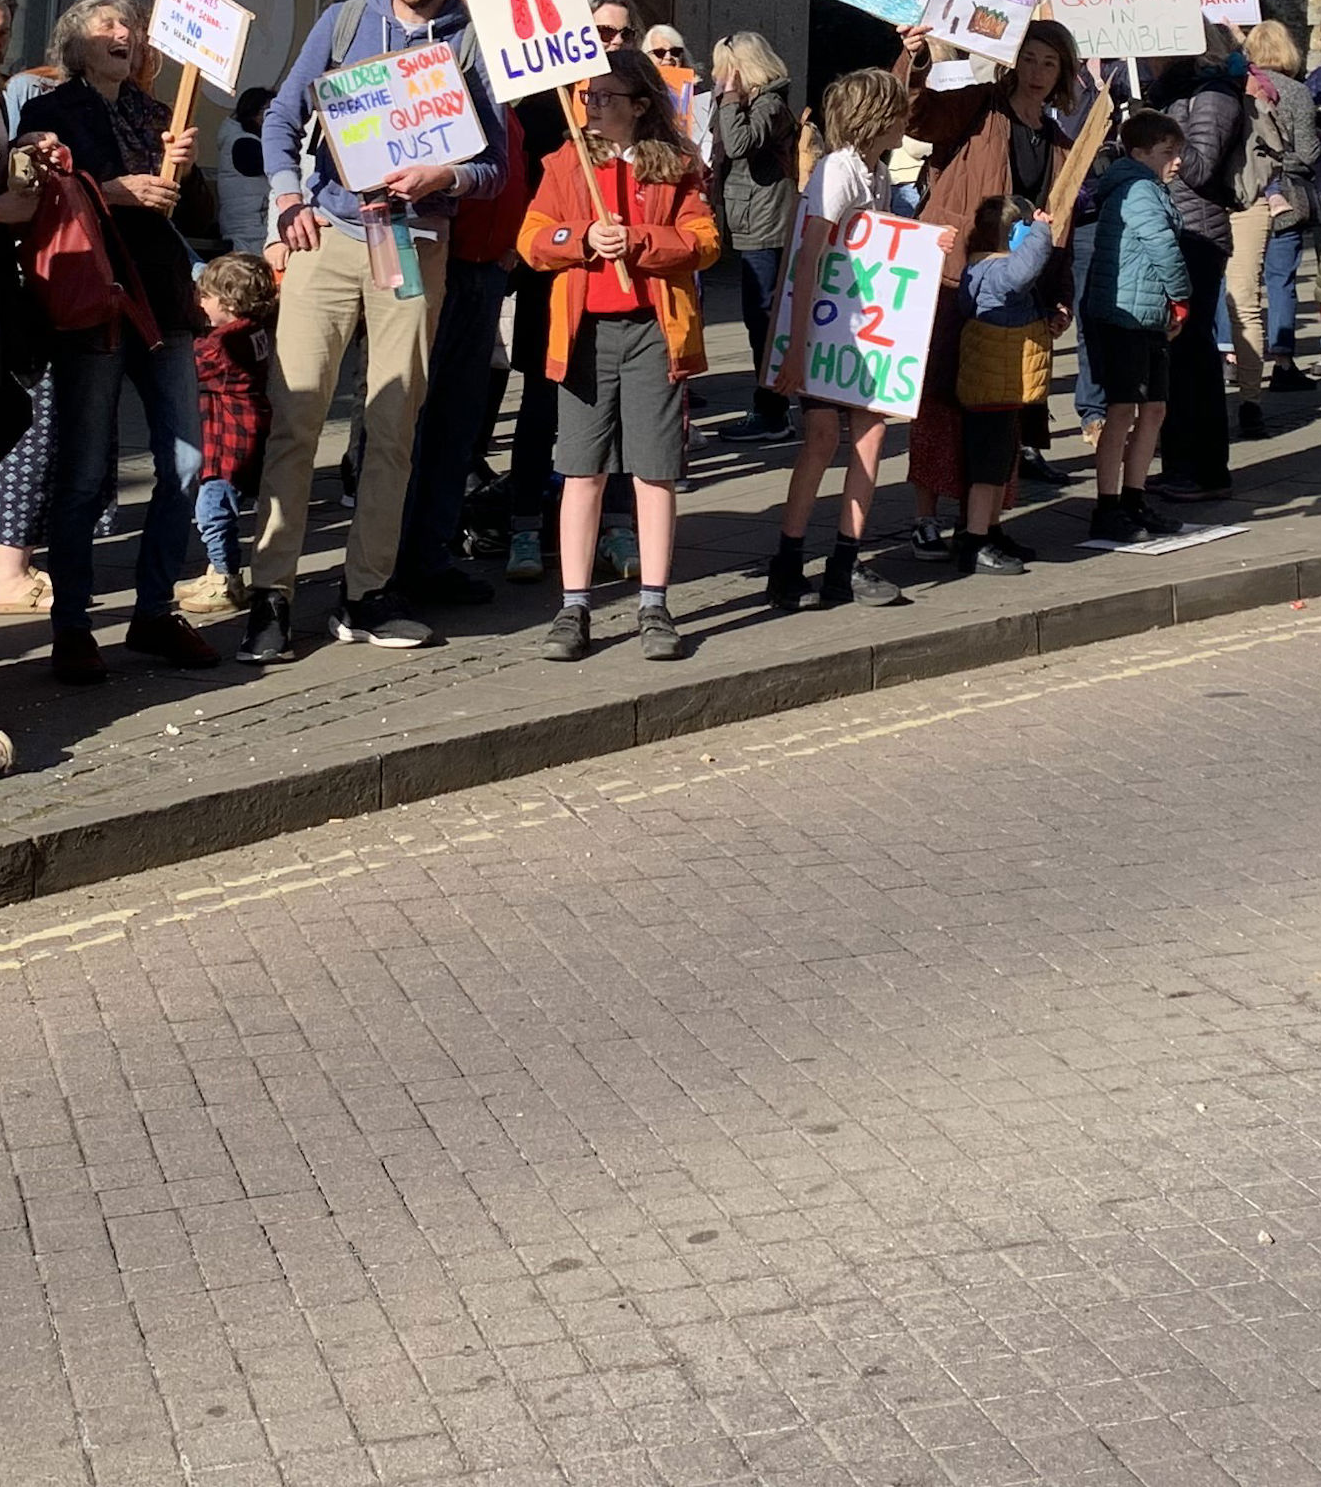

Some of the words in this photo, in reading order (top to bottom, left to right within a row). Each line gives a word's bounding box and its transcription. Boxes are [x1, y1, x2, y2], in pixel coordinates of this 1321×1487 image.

[170, 10, 184, 24] SAY
[187, 20, 203, 40] NO
[1111, 9, 1136, 24] IN
[500, 25, 598, 79] LUNGS
[1073, 25, 1189, 55] HAMBLE
[318, 63, 391, 100] CHILDREN
[397, 45, 451, 78] SHOULD
[328, 89, 393, 120] BREATHE
[389, 88, 466, 131] QUARRY
[386, 121, 454, 166] DUST
[788, 252, 920, 311] EXT
[857, 305, 895, 347] 2
[771, 334, 920, 403] SHOOLS
